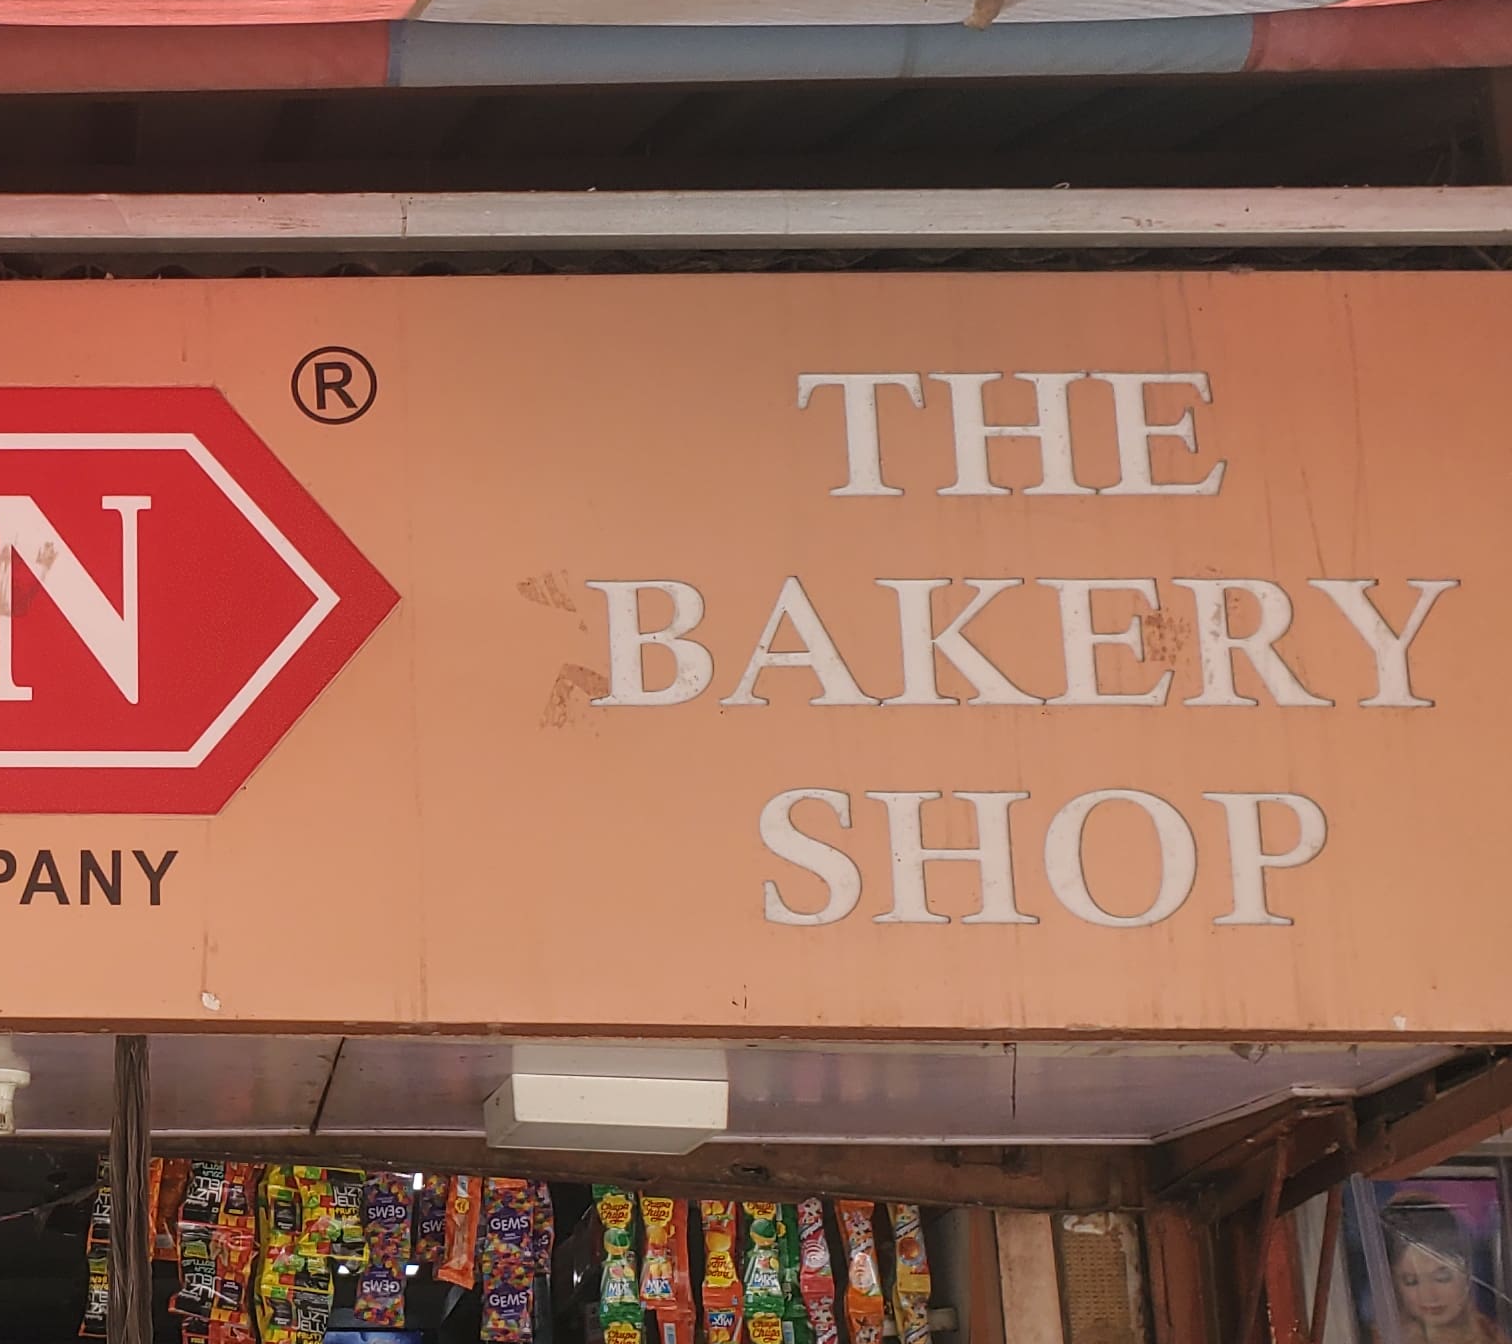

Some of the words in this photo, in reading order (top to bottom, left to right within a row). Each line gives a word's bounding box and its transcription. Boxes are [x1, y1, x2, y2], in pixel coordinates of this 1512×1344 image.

[797, 370, 1227, 497] THE
[585, 575, 1461, 708] BAKERY
[759, 788, 1327, 928] SHOP
[367, 1205, 406, 1219] GEMS
[490, 1216, 529, 1231] GEMS
[362, 1279, 401, 1294] GEMS
[489, 1291, 528, 1307] GEMS
